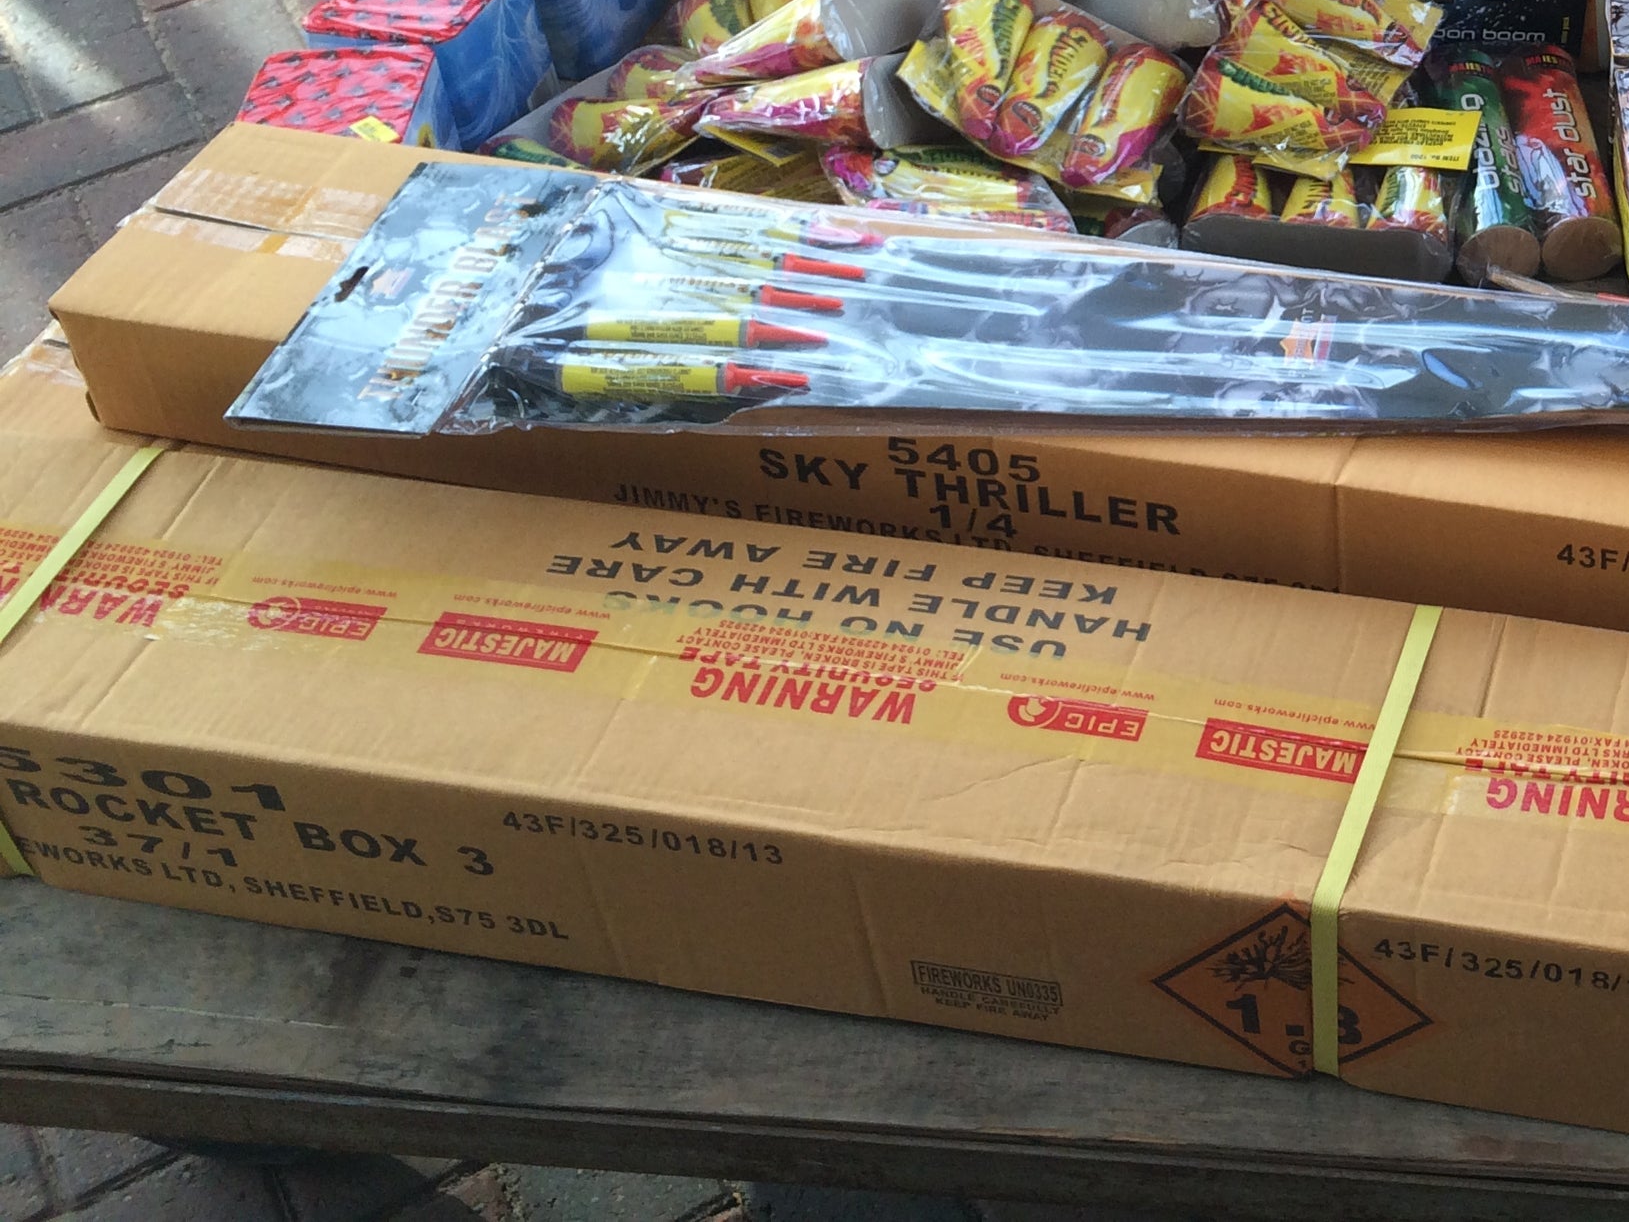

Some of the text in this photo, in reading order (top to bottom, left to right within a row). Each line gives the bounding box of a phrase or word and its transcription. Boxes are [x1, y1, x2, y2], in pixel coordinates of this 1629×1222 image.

[1543, 87, 1597, 199] star dust
[887, 436, 1041, 482] 5405
[614, 483, 943, 544] JIMMY'S FIREWORKS
[759, 448, 1181, 536] SKY THRILLER
[929, 504, 1018, 539] 1/4
[610, 531, 1119, 605] KEEP FIRE AWAY
[546, 555, 1152, 642] HANDLE WITH CARE
[434, 627, 576, 663] MAJESTIC
[602, 591, 1067, 660] USE NO HOOKS
[689, 666, 917, 725] WARNING
[1064, 712, 1141, 738] EPIC
[1209, 730, 1357, 776] MAJESTIC
[0, 746, 287, 812] 5301
[8, 779, 494, 877] ROCKET BOX 3
[77, 824, 240, 868] 37/1
[503, 811, 783, 865] 43F/325/018/13
[508, 915, 570, 941] 3DL
[918, 964, 1001, 995] FIREWORKS
[920, 987, 979, 1003] HANDLE
[1010, 1008, 1050, 1023] AWAY
